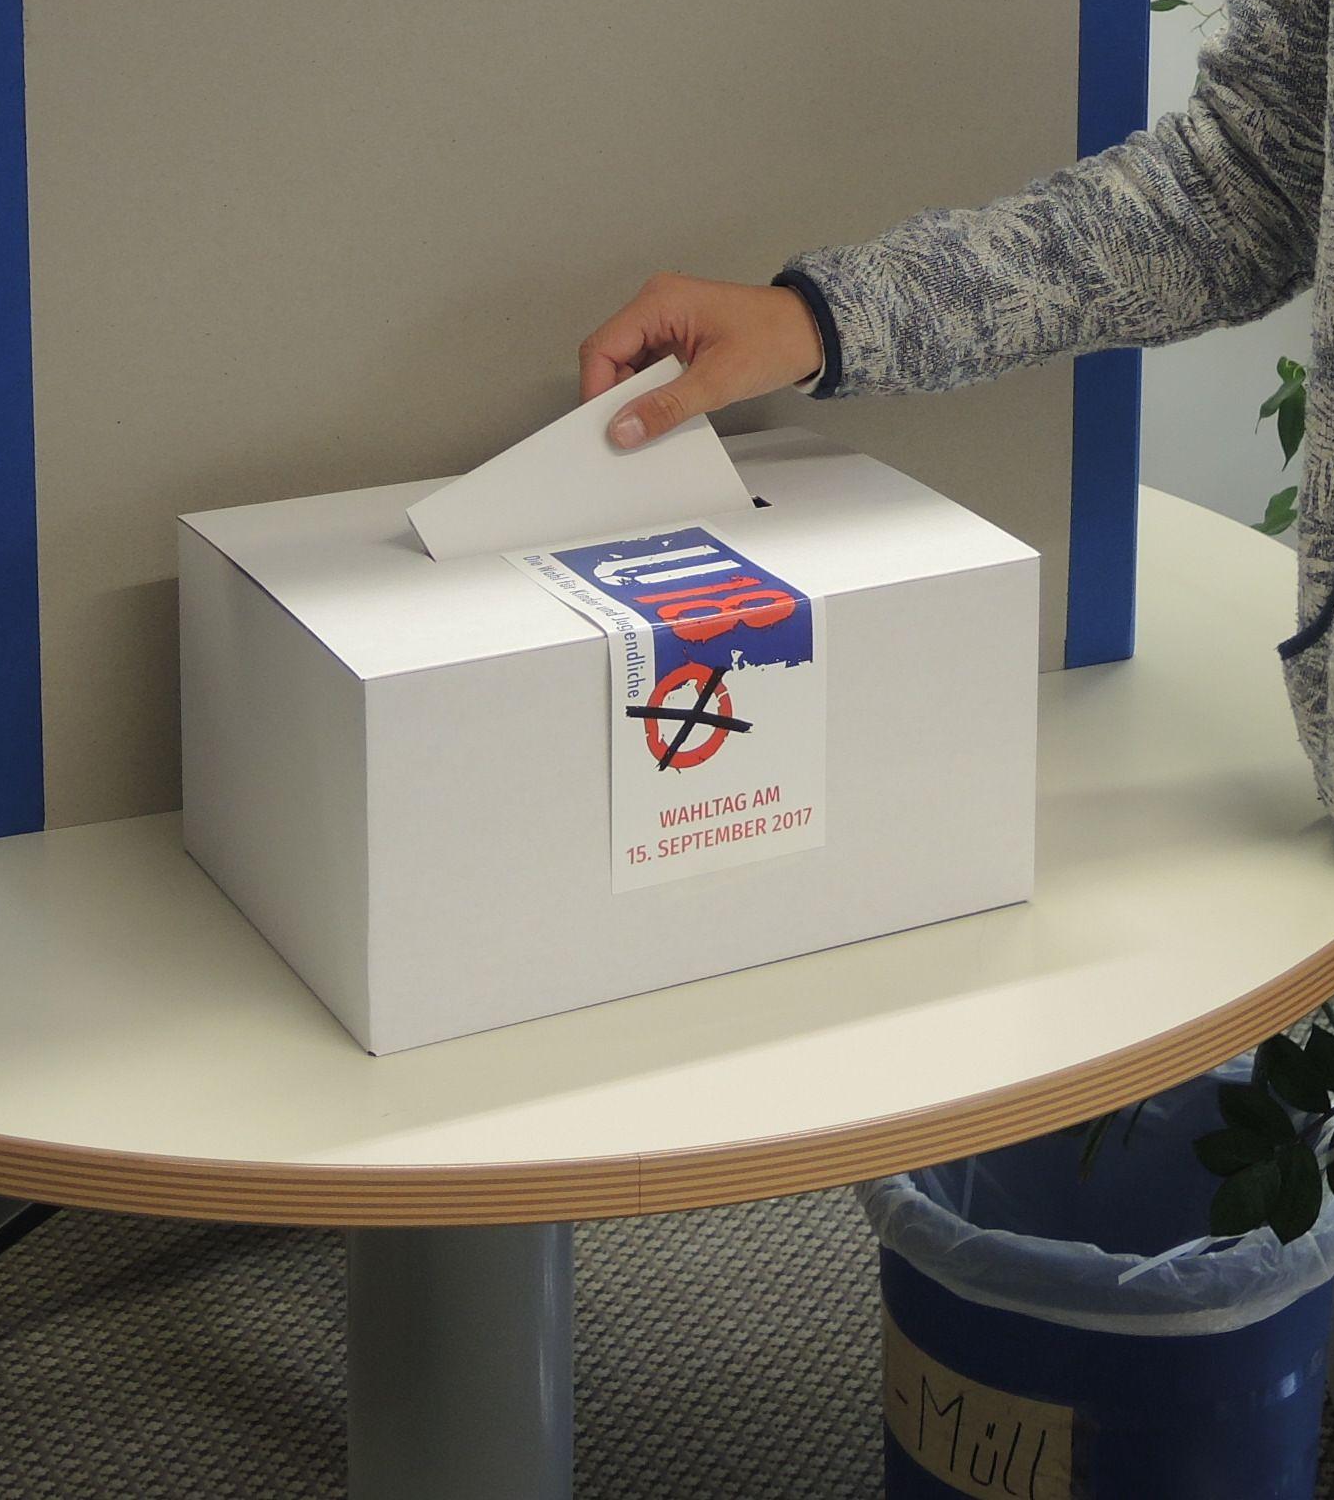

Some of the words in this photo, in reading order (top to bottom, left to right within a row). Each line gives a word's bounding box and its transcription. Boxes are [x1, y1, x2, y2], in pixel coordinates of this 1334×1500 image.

[612, 616, 646, 699] Jugendliche
[659, 793, 747, 828] WAHLTAG
[752, 785, 780, 808] AM
[626, 845, 652, 864] 15.
[657, 817, 767, 858] SEPTEMBER
[771, 807, 812, 832] 2017
